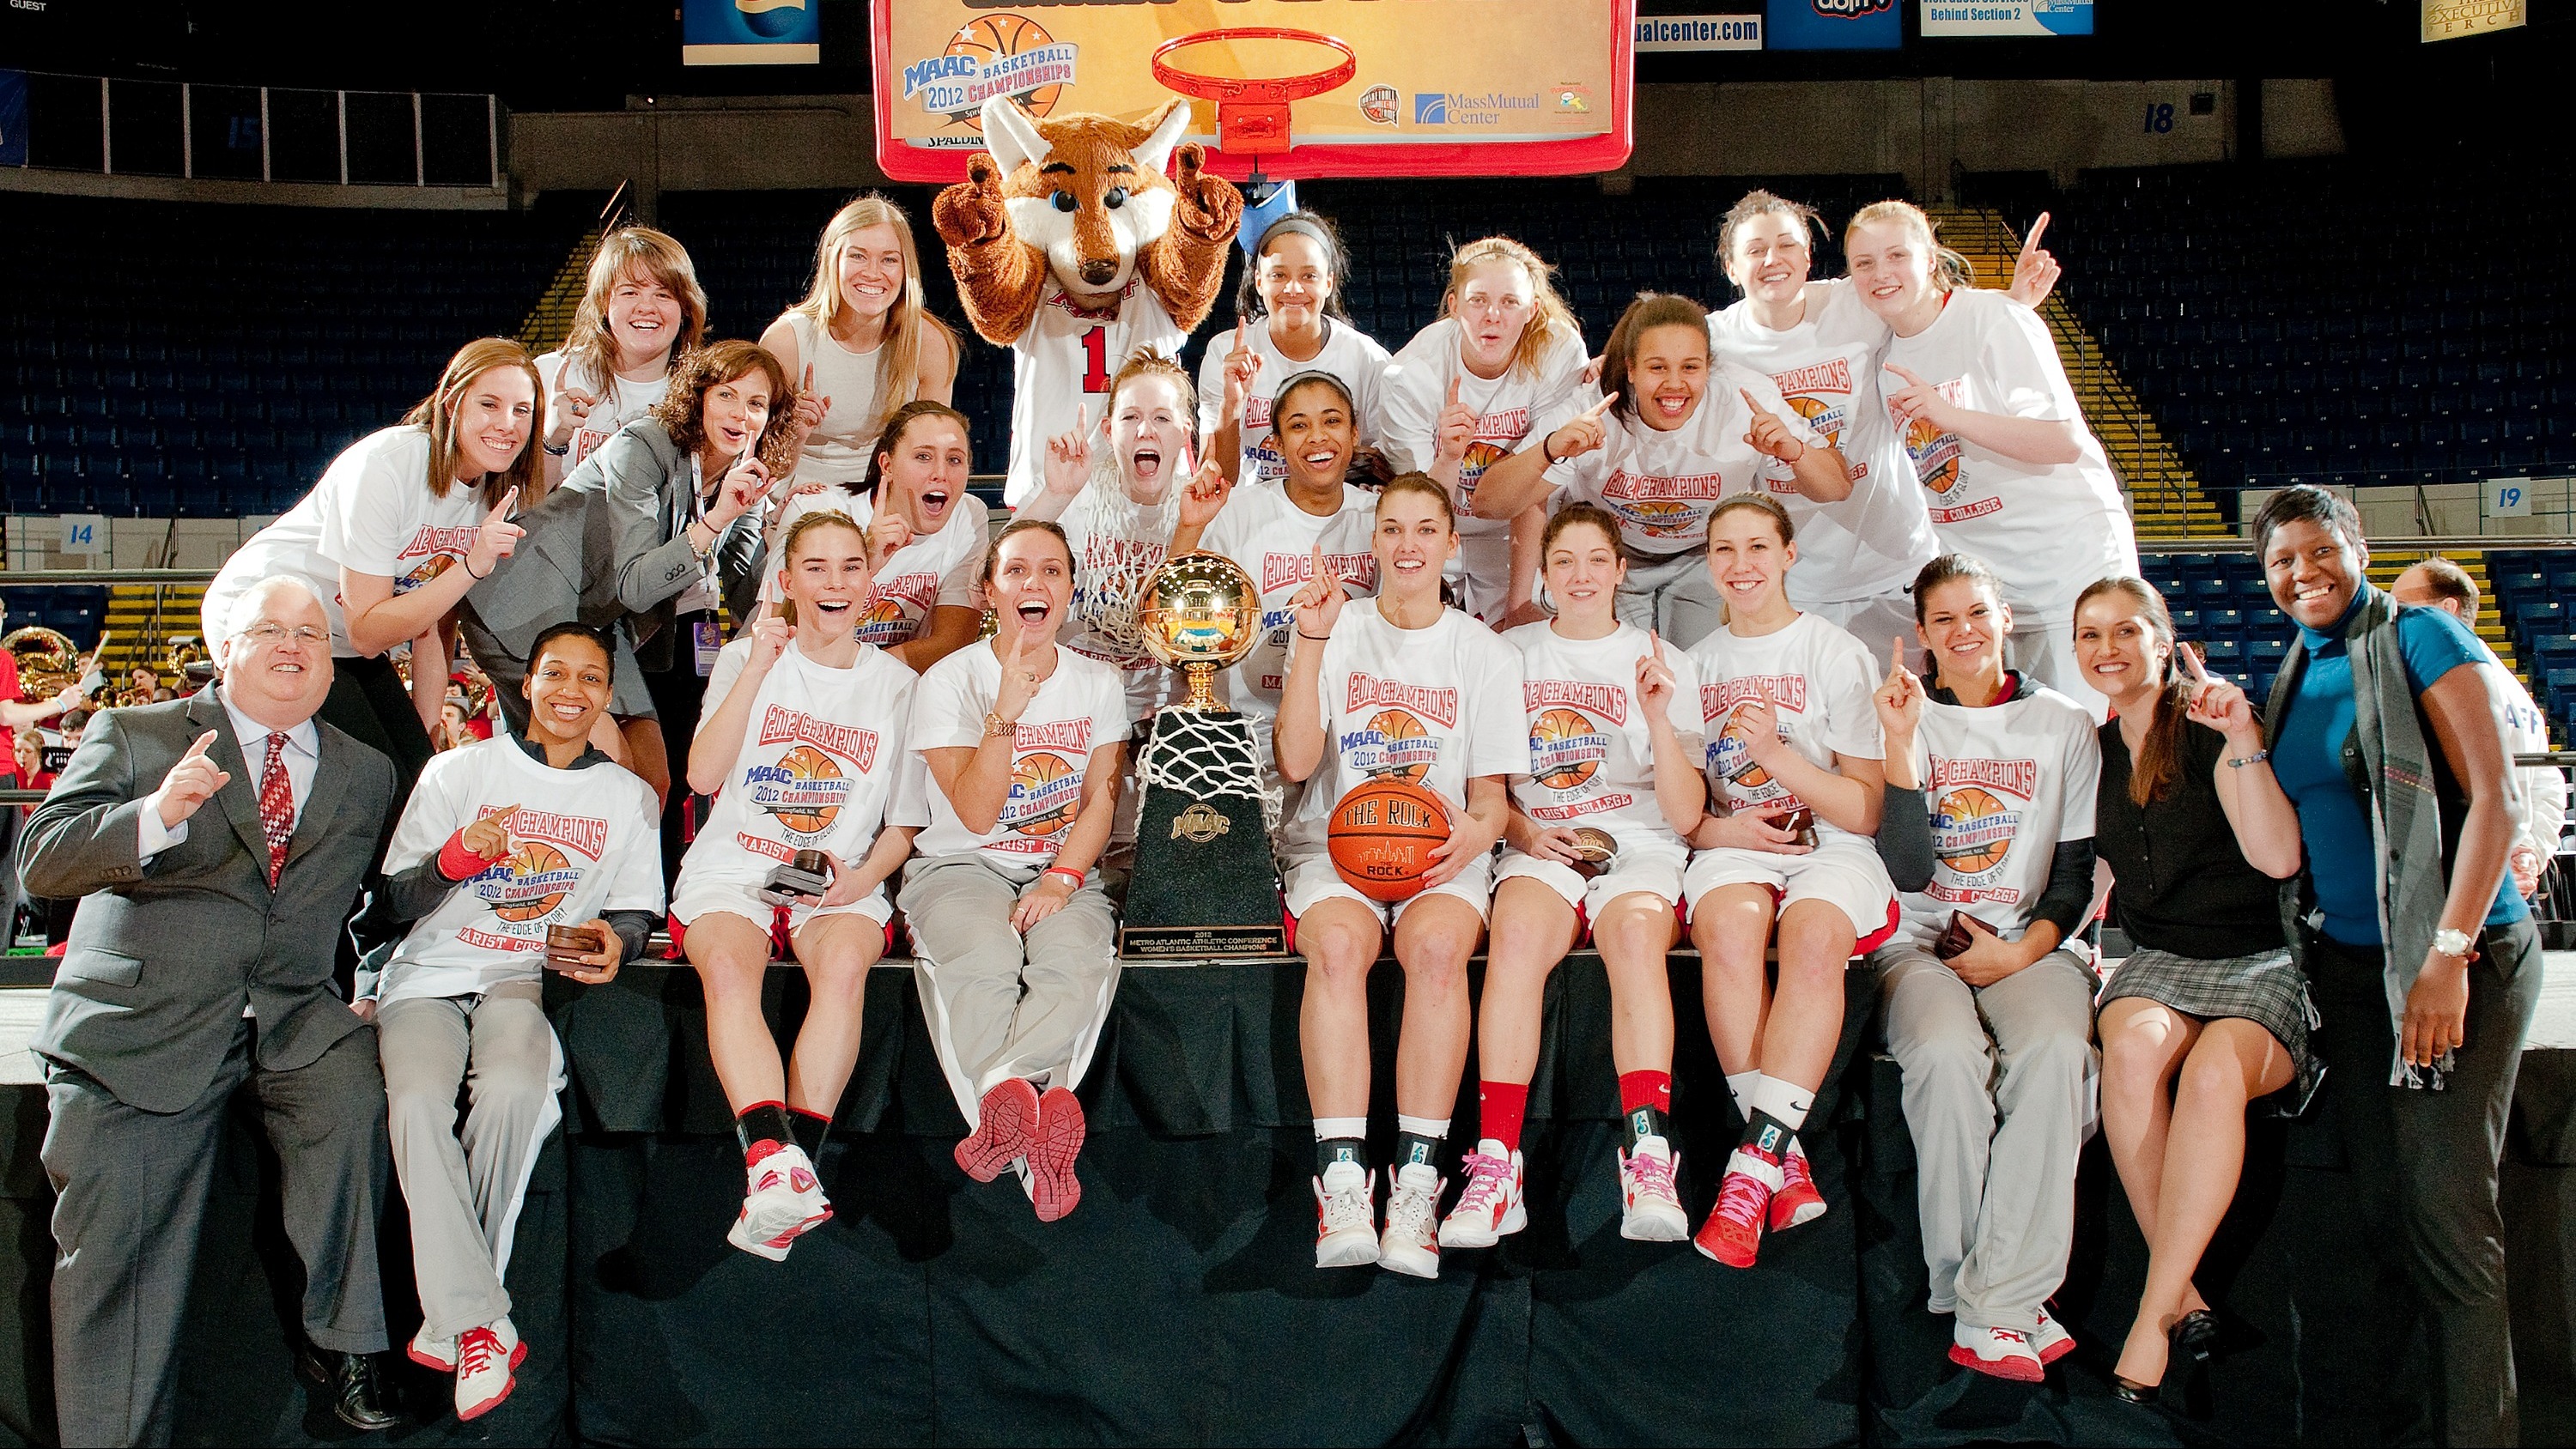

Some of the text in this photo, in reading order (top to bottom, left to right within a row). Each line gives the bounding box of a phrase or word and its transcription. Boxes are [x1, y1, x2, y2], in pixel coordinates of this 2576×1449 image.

[10, 0, 46, 11] GUEST
[1931, 8, 2021, 21] Behind Section 2
[983, 49, 1072, 80] BASKETBALL
[904, 56, 976, 96] MAAC
[928, 64, 1072, 108] 2012 CHAMPIONSHIPS
[1448, 94, 1539, 109] MassMutual
[1448, 110, 1500, 124] Center
[2145, 104, 2174, 133] 18
[1082, 326, 1110, 393] 1
[1607, 471, 1719, 499] 2012 CHAMPIONS
[2500, 488, 2522, 507] 19
[1950, 499, 2000, 521] COLLEGE
[70, 524, 94, 544] 14
[1265, 555, 1297, 592] 2012
[1273, 630, 1289, 643] 201
[1350, 673, 1455, 724] 2012 CHAMPIONS
[1542, 681, 1625, 723] CHAMPIONS
[1702, 685, 1728, 716] 2012
[765, 706, 877, 769] 2012 CHAMPIONS
[1018, 720, 1091, 749] CHAMPIONS
[1340, 731, 1384, 755] MAAC
[1548, 737, 1607, 751] BASKETBALL
[1354, 752, 1376, 766] 2012
[1540, 748, 1606, 768] CHAMPIONSHIPS
[743, 766, 849, 791] MAAC BASKETBALL
[1030, 774, 1083, 800] BASKETBAL
[1950, 761, 2035, 798] CHAMPIONS
[756, 785, 846, 803] 2012 CHAMPIONSHIPS
[1553, 791, 1564, 803] THE
[1566, 788, 1583, 803] EDGE
[1747, 783, 1780, 800] THE EDGE
[999, 806, 1017, 821] 012
[1344, 799, 1431, 828] THE ROCK
[1575, 794, 1630, 814] COLLEGE
[518, 811, 604, 857] CHAMPIONS
[1171, 814, 1230, 840] MAAC
[1958, 815, 2019, 833] BASKETBALL
[739, 834, 788, 859] MARIST
[781, 828, 795, 843] THE
[795, 835, 811, 848] EDGE
[1933, 826, 2016, 848] 12 CHAMPIONSHIPS
[518, 871, 579, 886] BASKETBALL
[1367, 866, 1403, 876] ROCK
[1951, 872, 1965, 886] THE
[1967, 875, 1987, 887] EDGE
[1987, 871, 1996, 883] OF
[480, 882, 575, 899] 2012 CHAMPIONSHIPS
[1925, 886, 1963, 901] ARIST
[496, 906, 568, 935] THE EDGE OF GLORY
